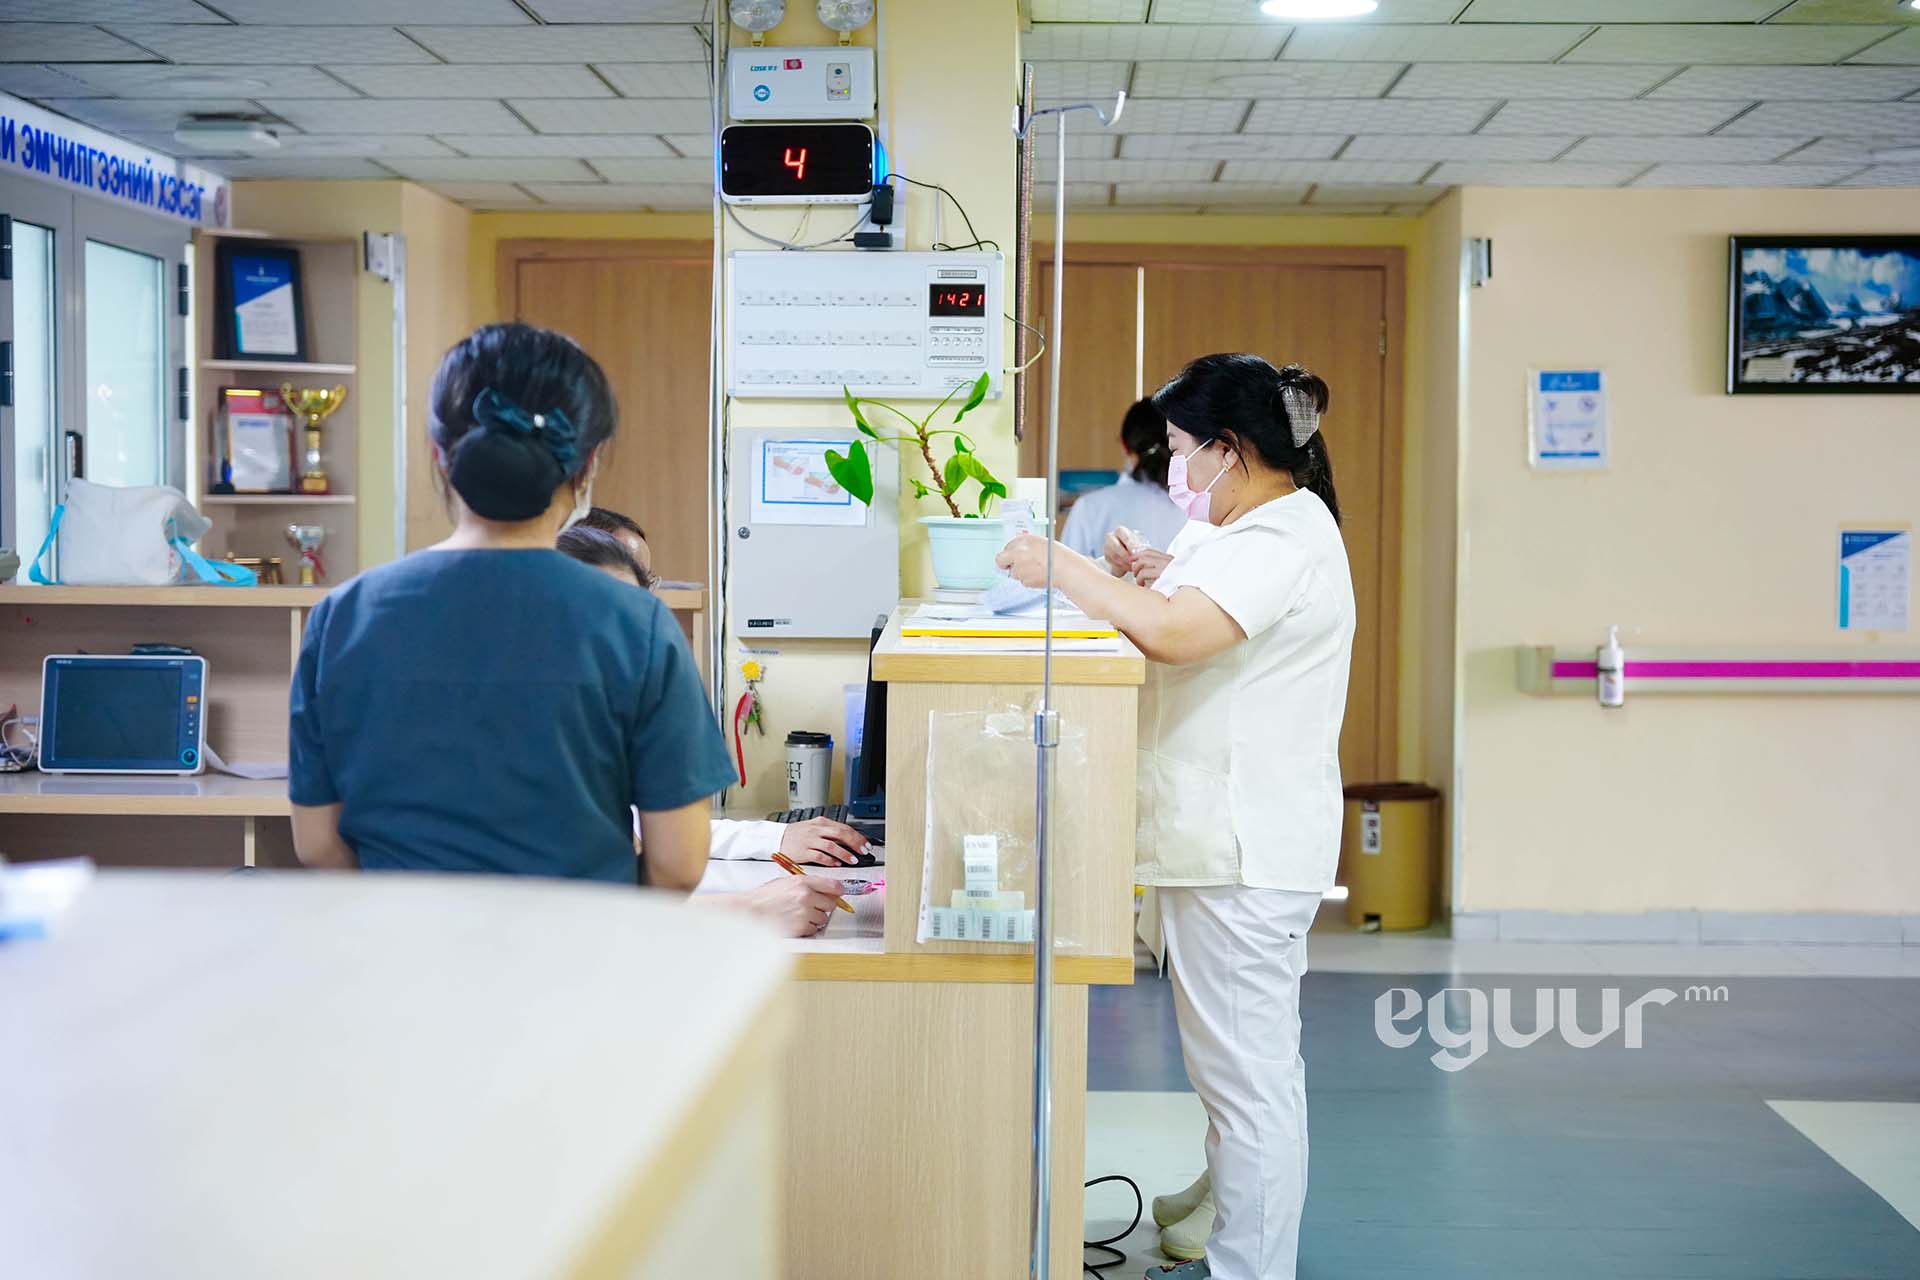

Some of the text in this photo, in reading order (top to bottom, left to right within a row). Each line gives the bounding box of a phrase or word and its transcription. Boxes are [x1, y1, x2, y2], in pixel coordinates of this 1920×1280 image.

[0, 116, 205, 221] И ЭМЧИЛГЭЭНИЙ ХЭСЭГ
[784, 148, 806, 180] 4
[939, 292, 983, 307] 1421
